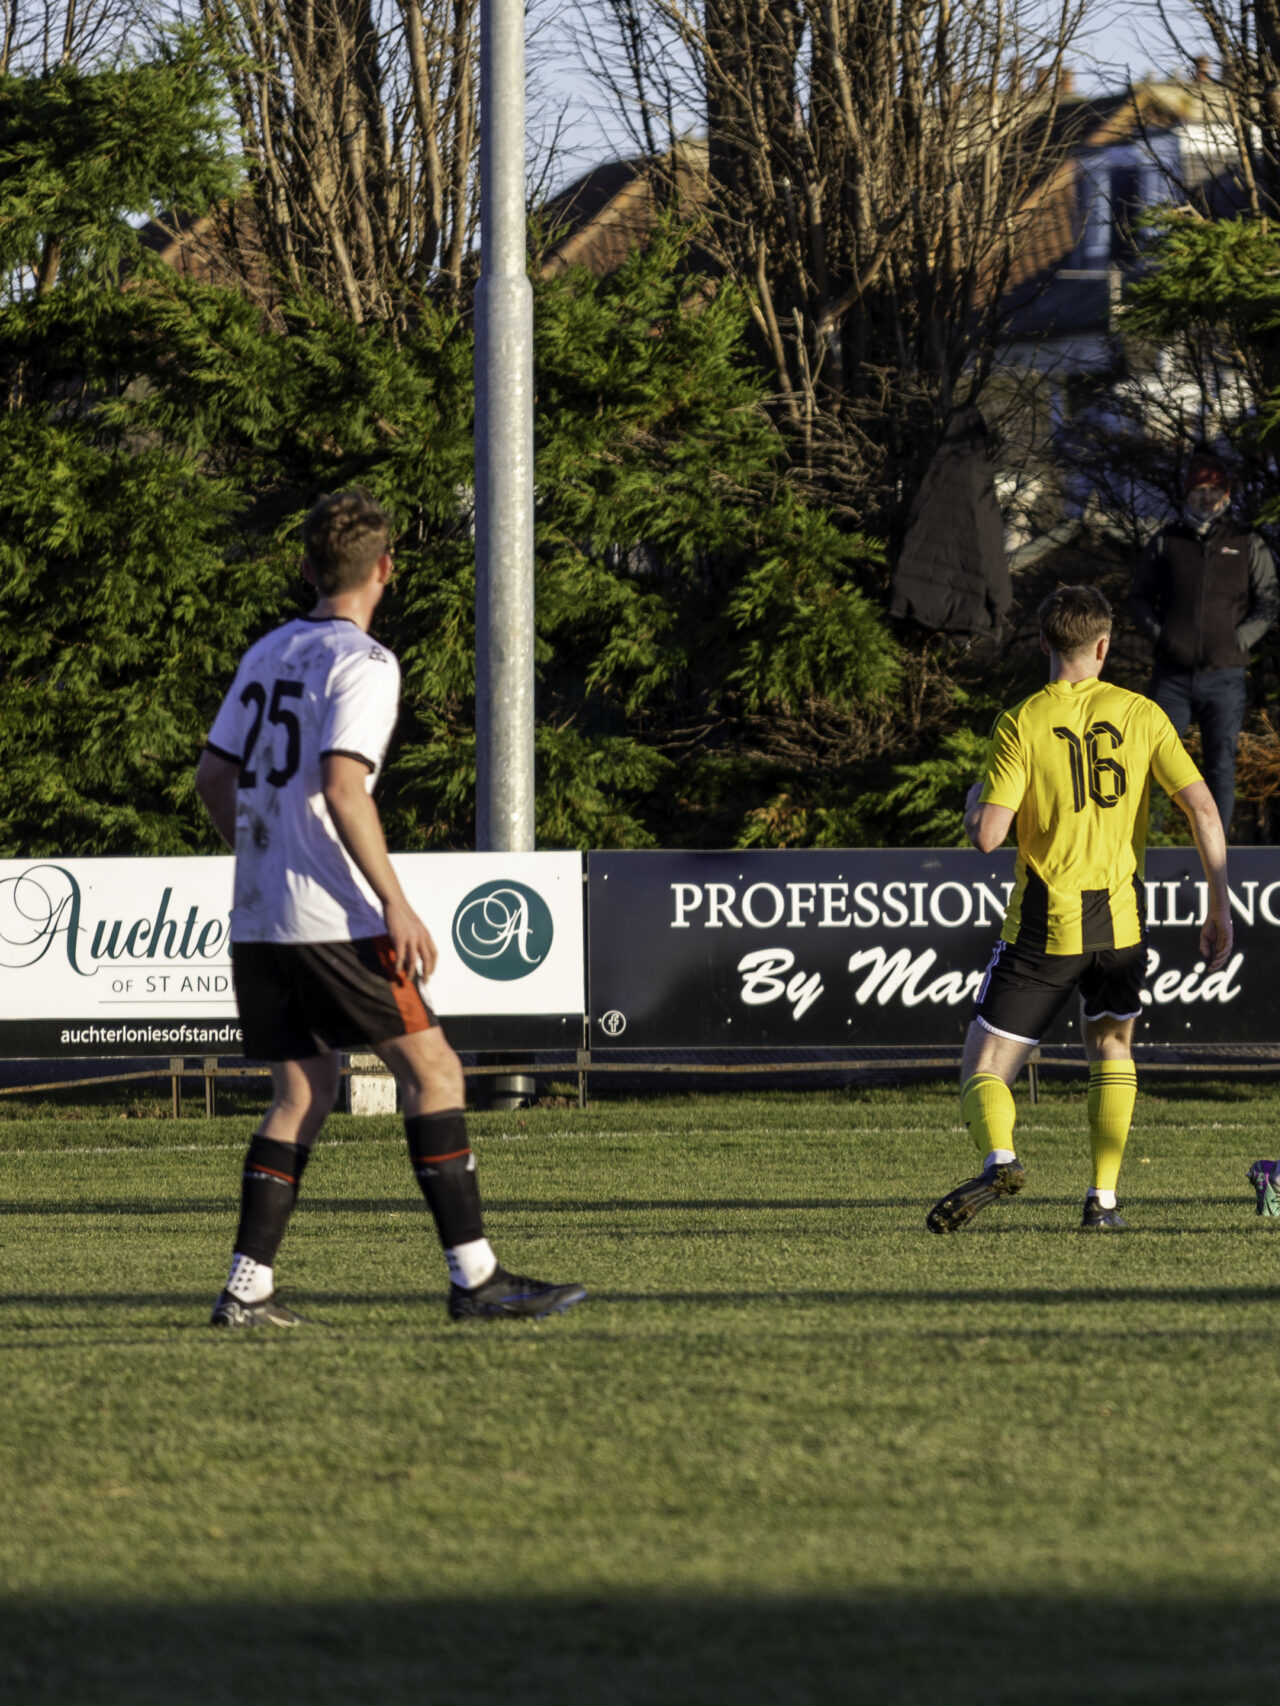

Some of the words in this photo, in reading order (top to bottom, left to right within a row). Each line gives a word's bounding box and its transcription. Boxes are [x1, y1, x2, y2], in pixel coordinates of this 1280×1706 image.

[238, 679, 304, 789] 25
[1053, 720, 1126, 814] 16
[0, 864, 233, 977] Auchte
[670, 881, 1016, 929] PROFESSION
[111, 979, 134, 993] OF
[145, 975, 171, 993] ST
[180, 975, 237, 993] AND
[737, 947, 825, 1022] By
[848, 945, 988, 1008] Mar
[60, 1024, 244, 1044] auchterloniesofstandre
